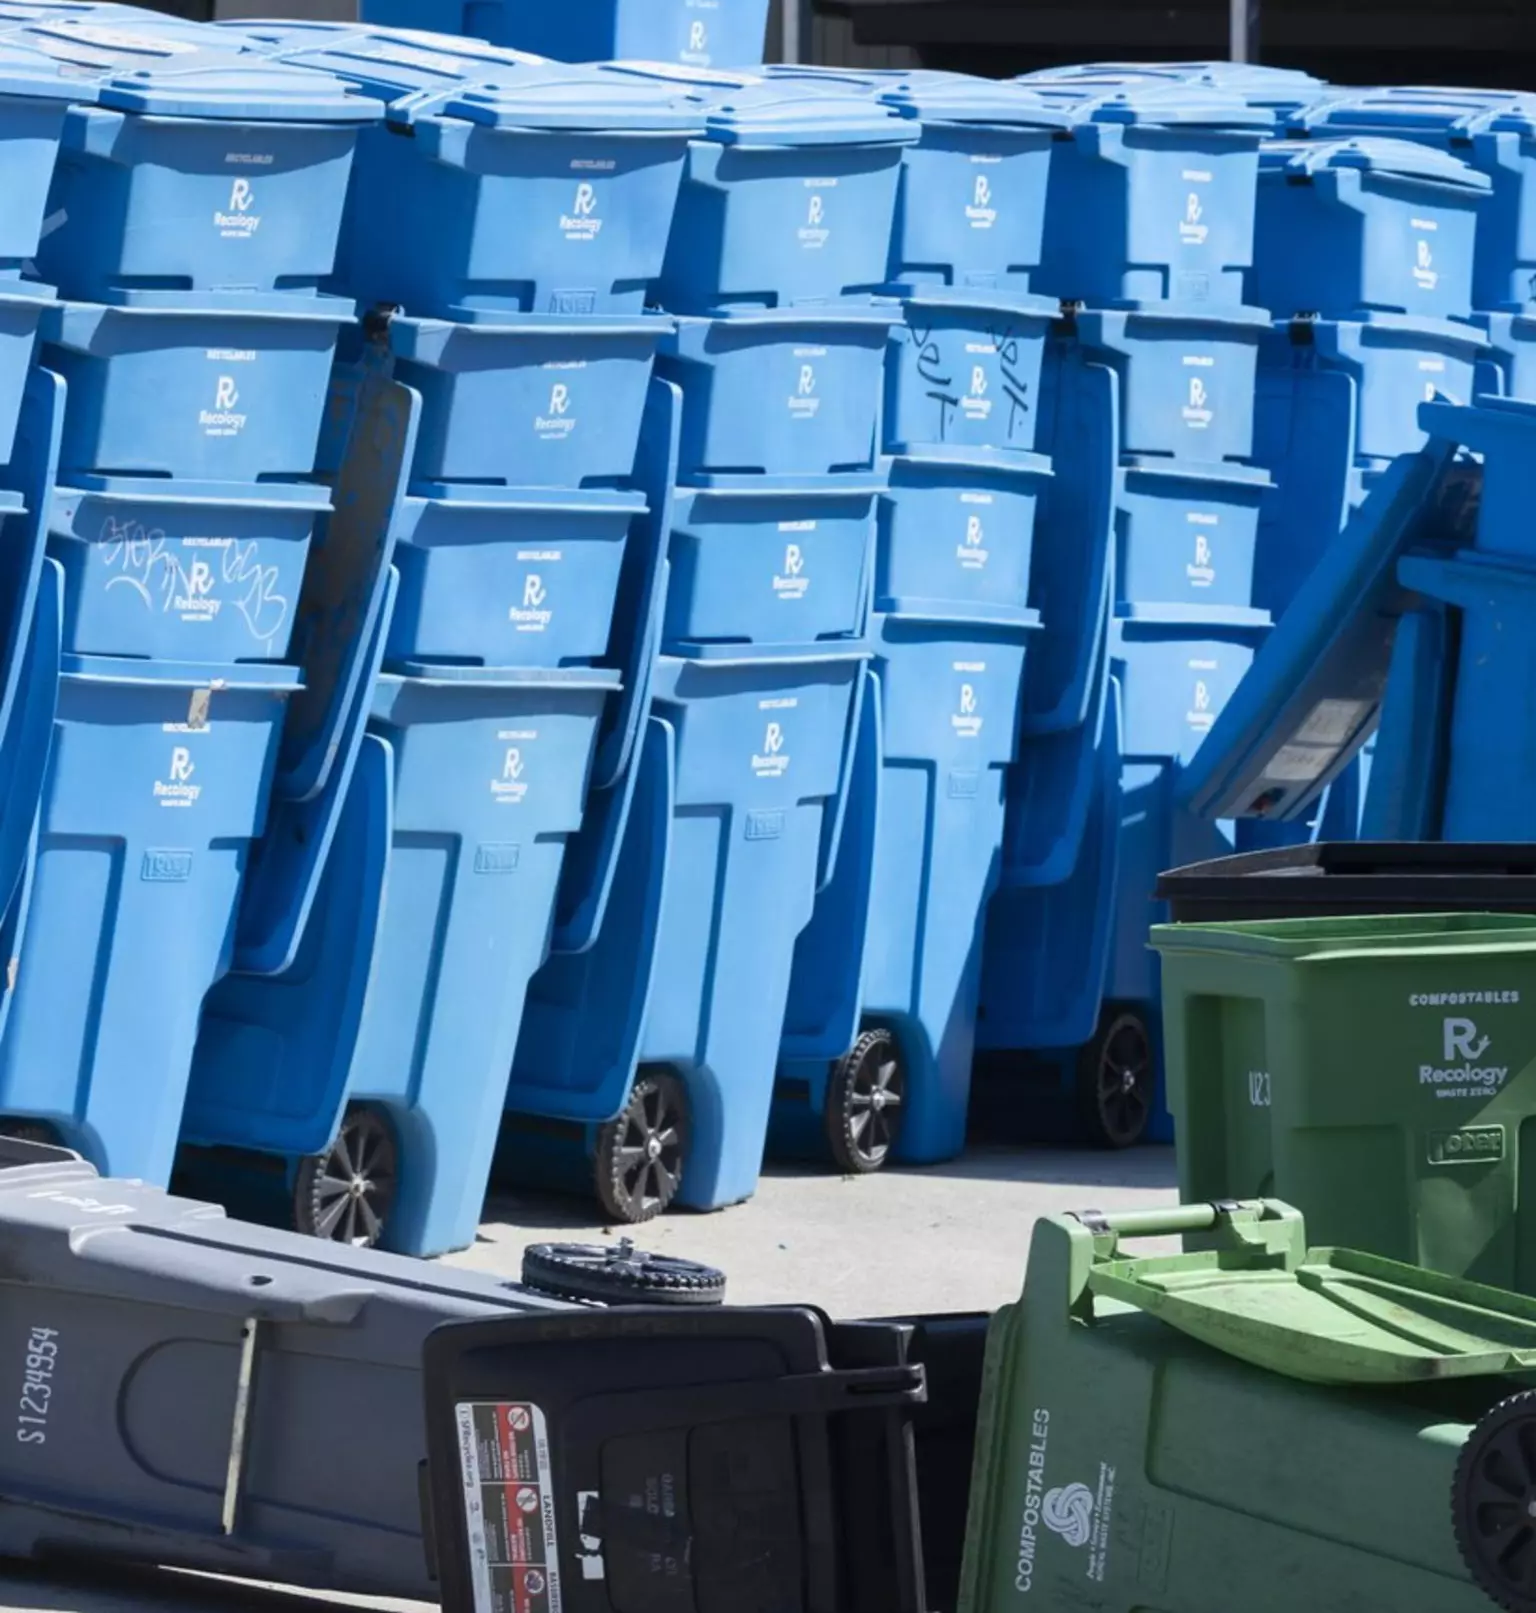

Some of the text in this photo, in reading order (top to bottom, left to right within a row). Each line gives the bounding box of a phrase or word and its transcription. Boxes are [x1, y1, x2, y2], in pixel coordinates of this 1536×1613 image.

[1409, 990, 1520, 1006] COMPOSTABLES
[1443, 1017, 1491, 1062] R
[1418, 1063, 1508, 1099] Recology
[17, 1326, 59, 1444] S1234954
[1014, 1407, 1051, 1593] COMPOSTABLES
